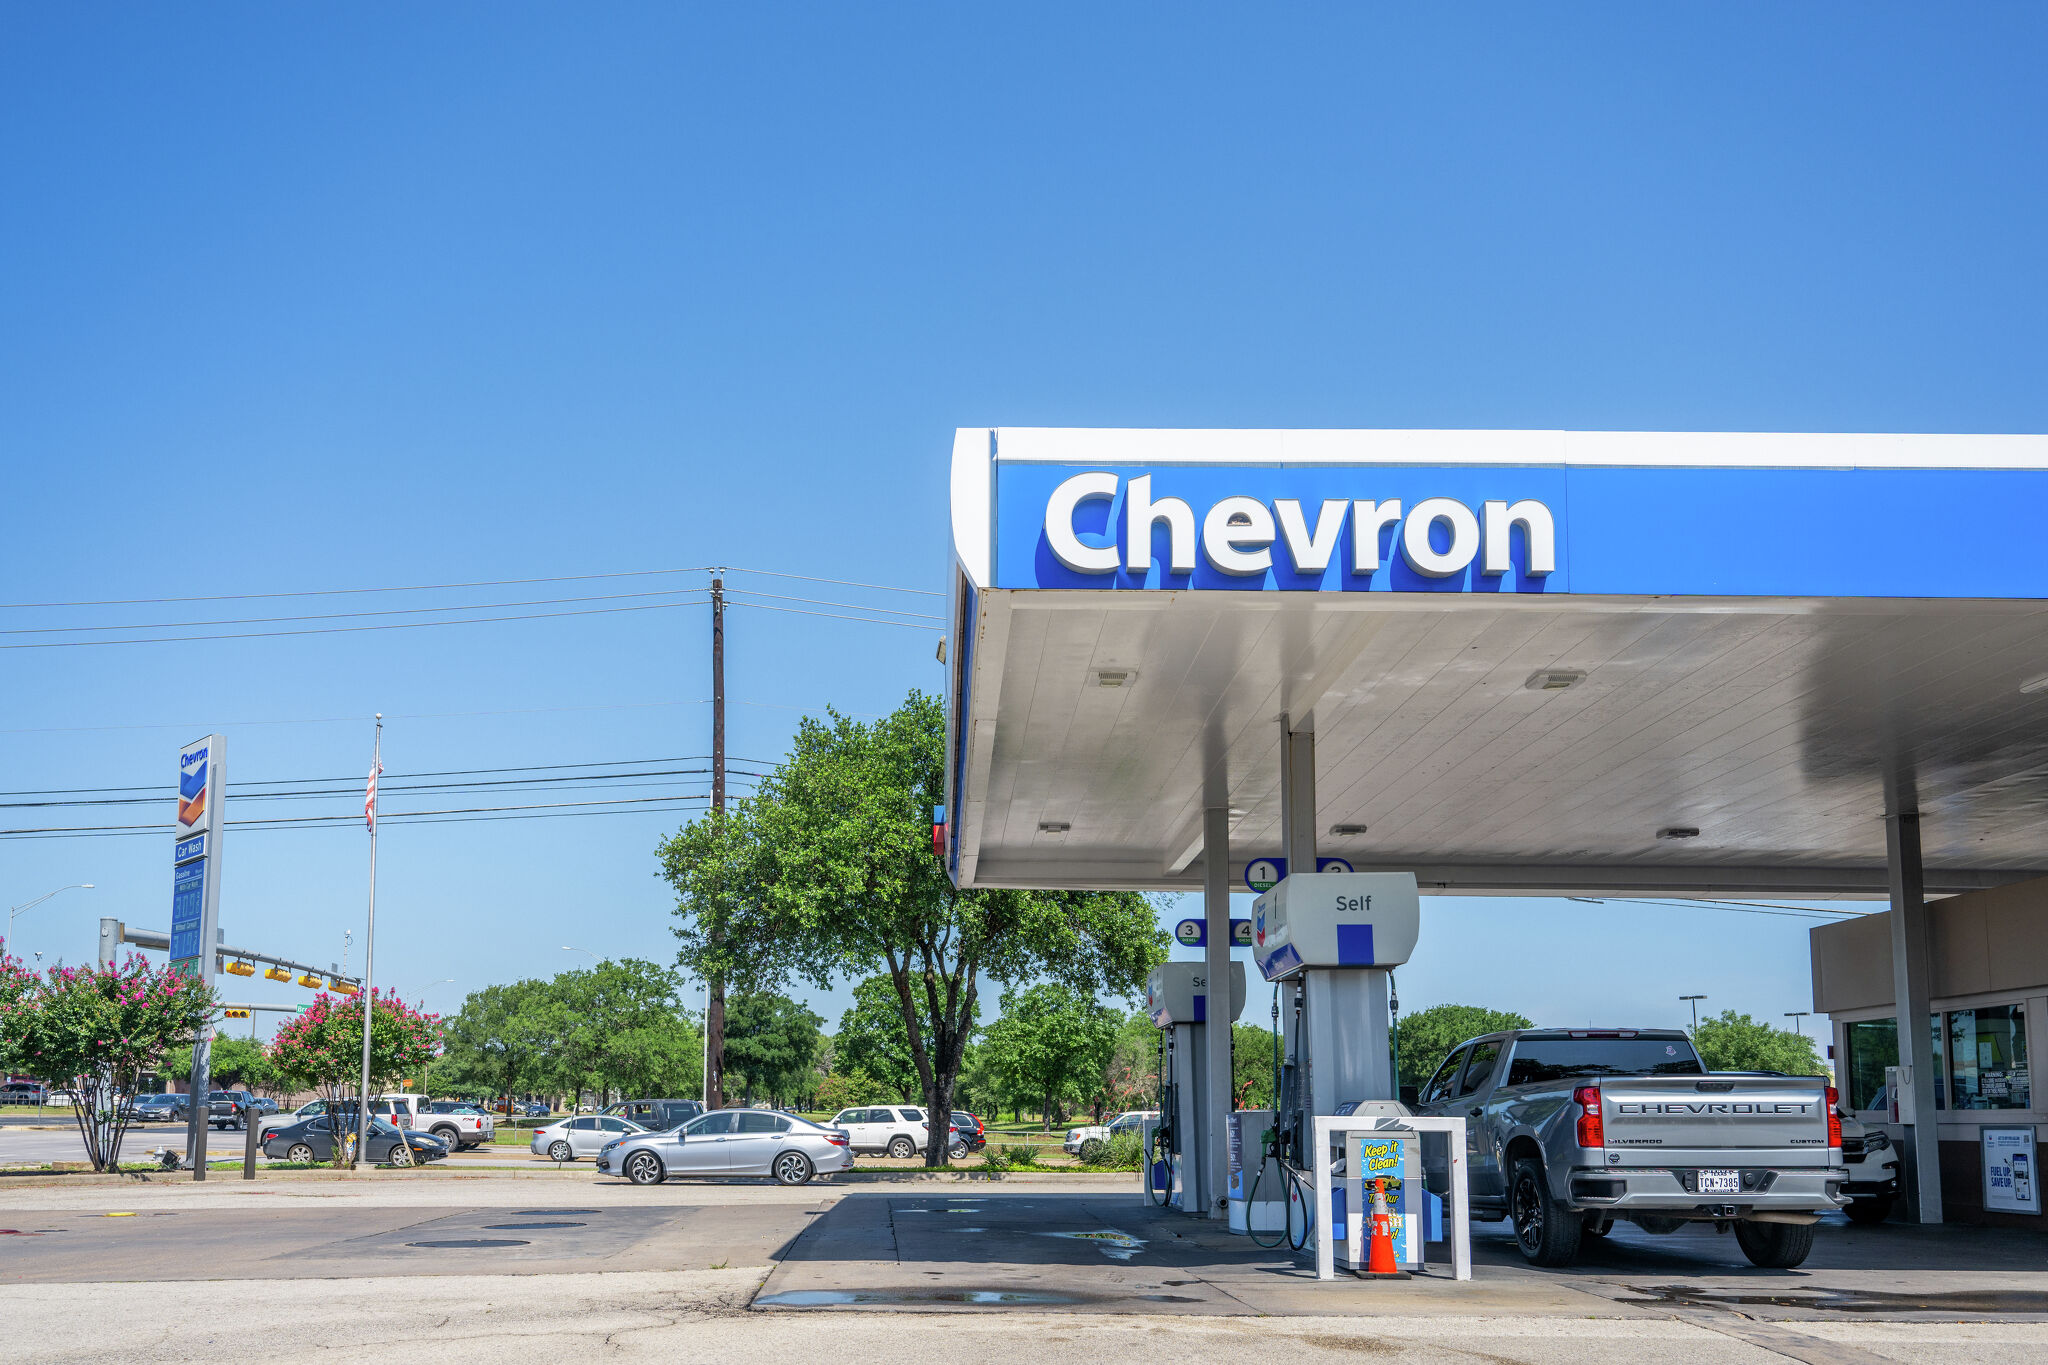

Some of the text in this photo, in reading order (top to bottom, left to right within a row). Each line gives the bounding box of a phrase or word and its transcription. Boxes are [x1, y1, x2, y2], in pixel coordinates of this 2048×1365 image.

[1045, 471, 1556, 579] Chevron
[180, 746, 208, 769] Chevron
[178, 841, 202, 857] Car Wash
[175, 870, 190, 880] Gasoline
[1259, 866, 1266, 880] 1
[1336, 895, 1372, 911] Self
[1185, 925, 1194, 936] 3
[1241, 925, 1252, 936] 4
[1619, 1104, 1813, 1114] CHEVROLET
[1364, 1140, 1399, 1158] Keep it
[1368, 1154, 1399, 1171] Clean!
[1990, 1166, 2011, 1177] FUEL UP.
[1991, 1177, 2012, 1188] SAVE UP.
[1385, 1192, 1399, 1204] Our
